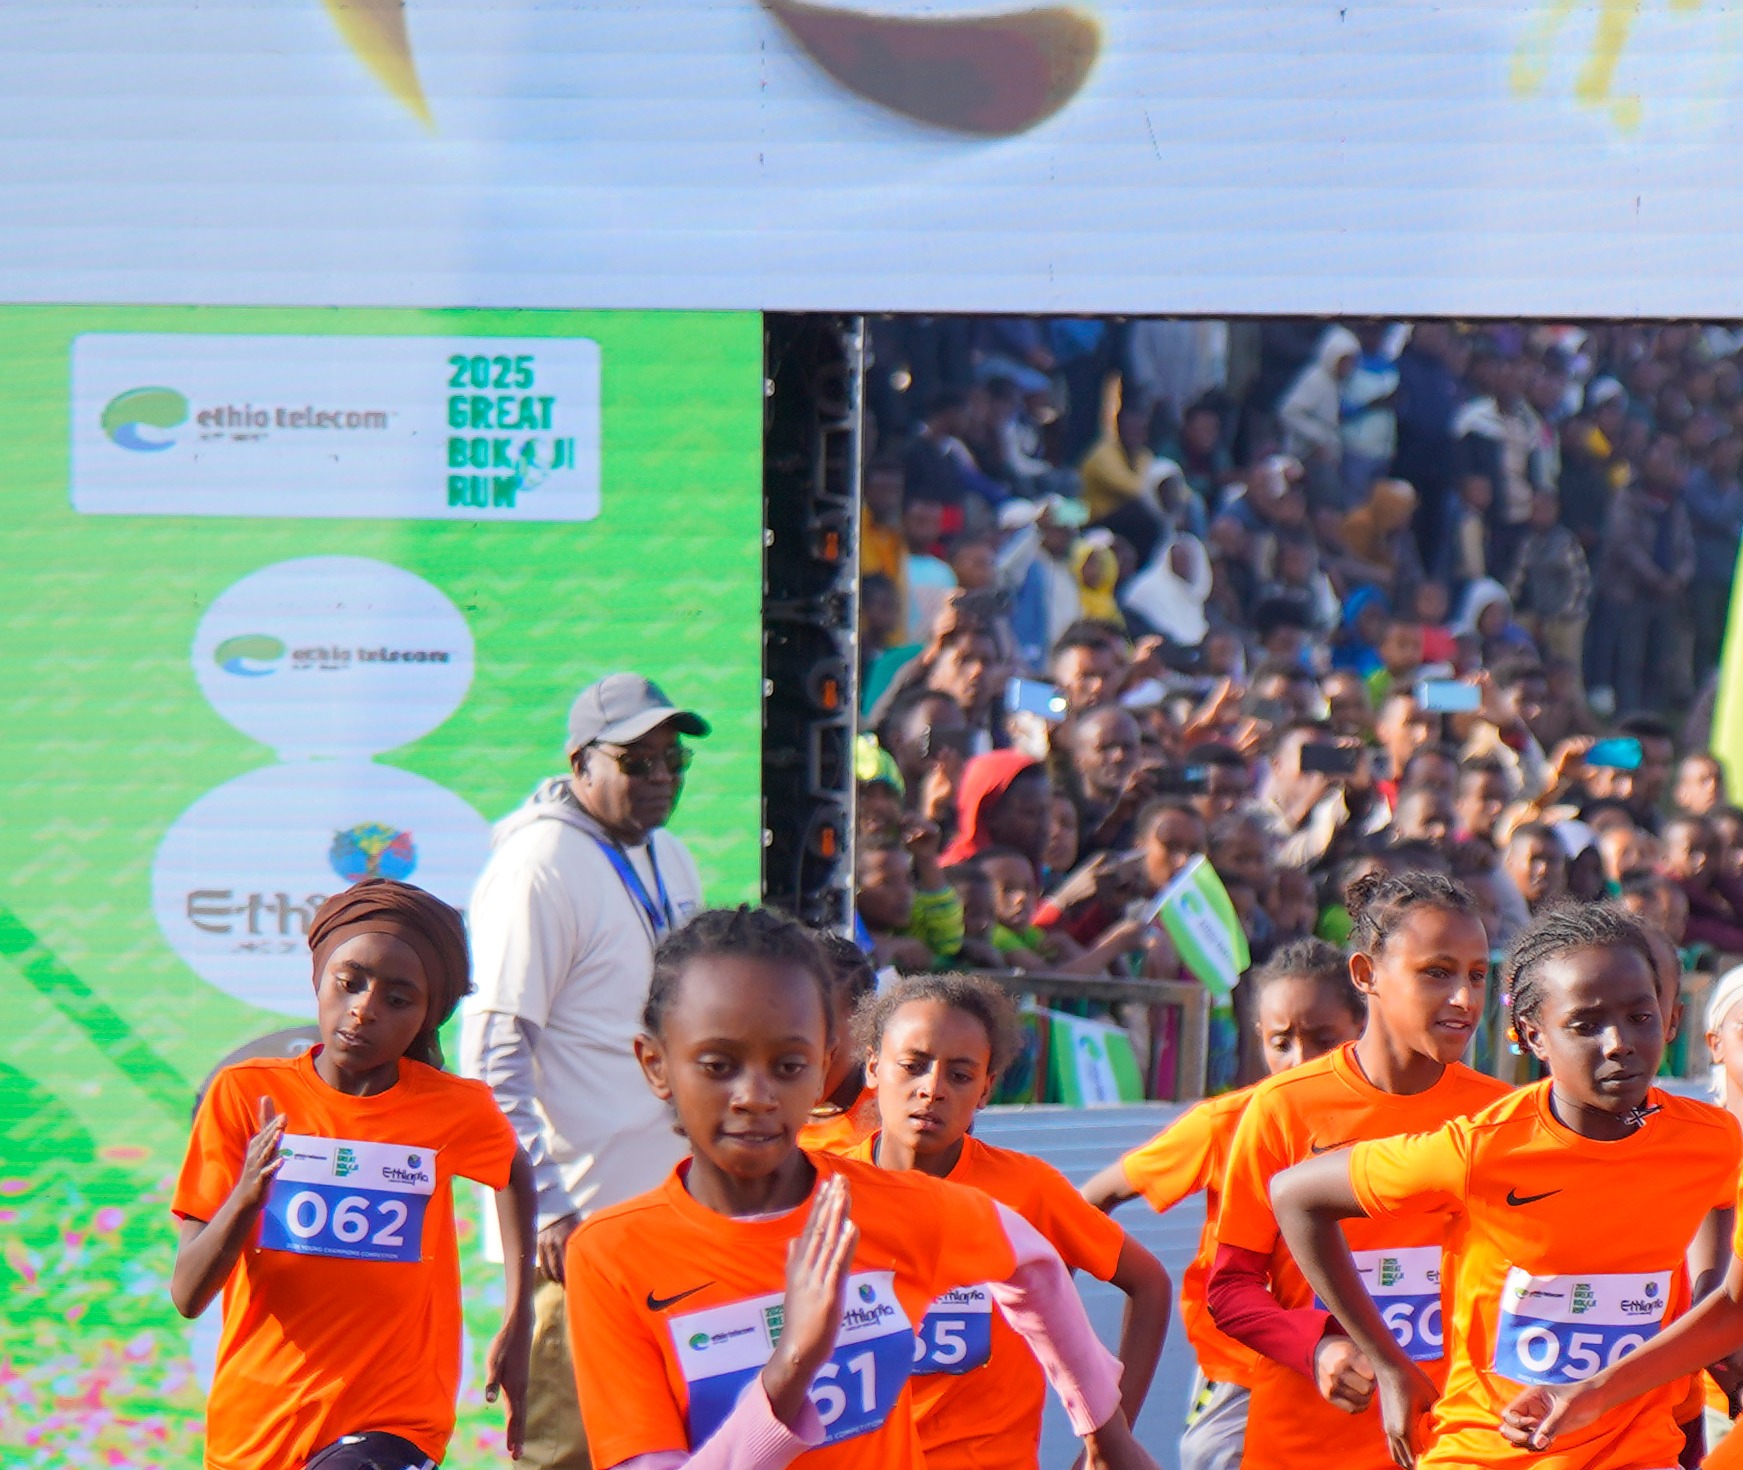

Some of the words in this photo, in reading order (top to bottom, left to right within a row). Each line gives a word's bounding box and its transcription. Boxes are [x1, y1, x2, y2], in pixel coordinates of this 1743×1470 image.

[448, 355, 535, 389] 2025
[197, 404, 268, 430] ethio
[274, 405, 387, 430] telecom
[448, 395, 557, 429] GREAT
[448, 475, 518, 508] RUN
[286, 1190, 408, 1247] 062
[1381, 1300, 1443, 1348] 60
[807, 1350, 877, 1427] 61
